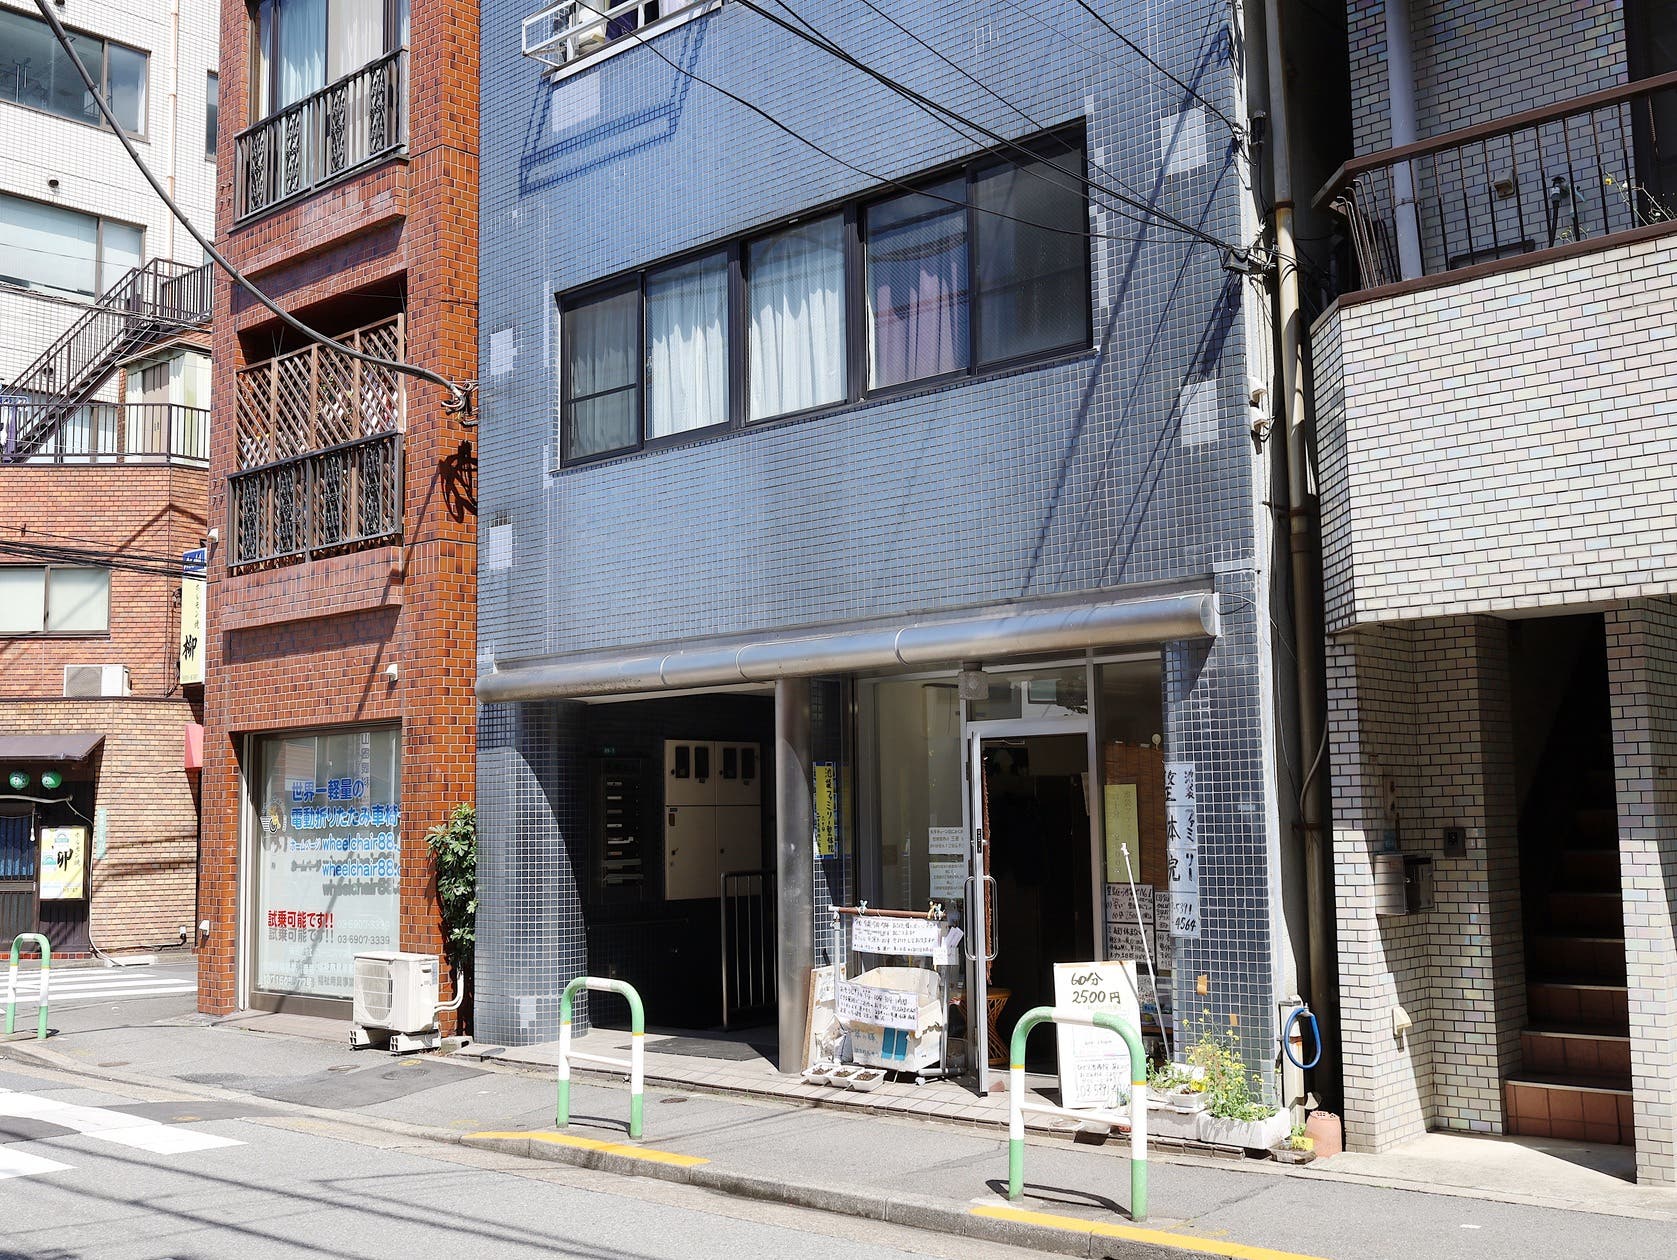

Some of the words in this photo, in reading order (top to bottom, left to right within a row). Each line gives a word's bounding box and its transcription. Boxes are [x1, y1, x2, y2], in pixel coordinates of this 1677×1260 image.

[291, 778, 365, 802] 世界一軽量の
[290, 804, 400, 830] 電動折りたたみ車椅
[1071, 972, 1103, 986] 60分
[1072, 990, 1121, 1005] 2500円
